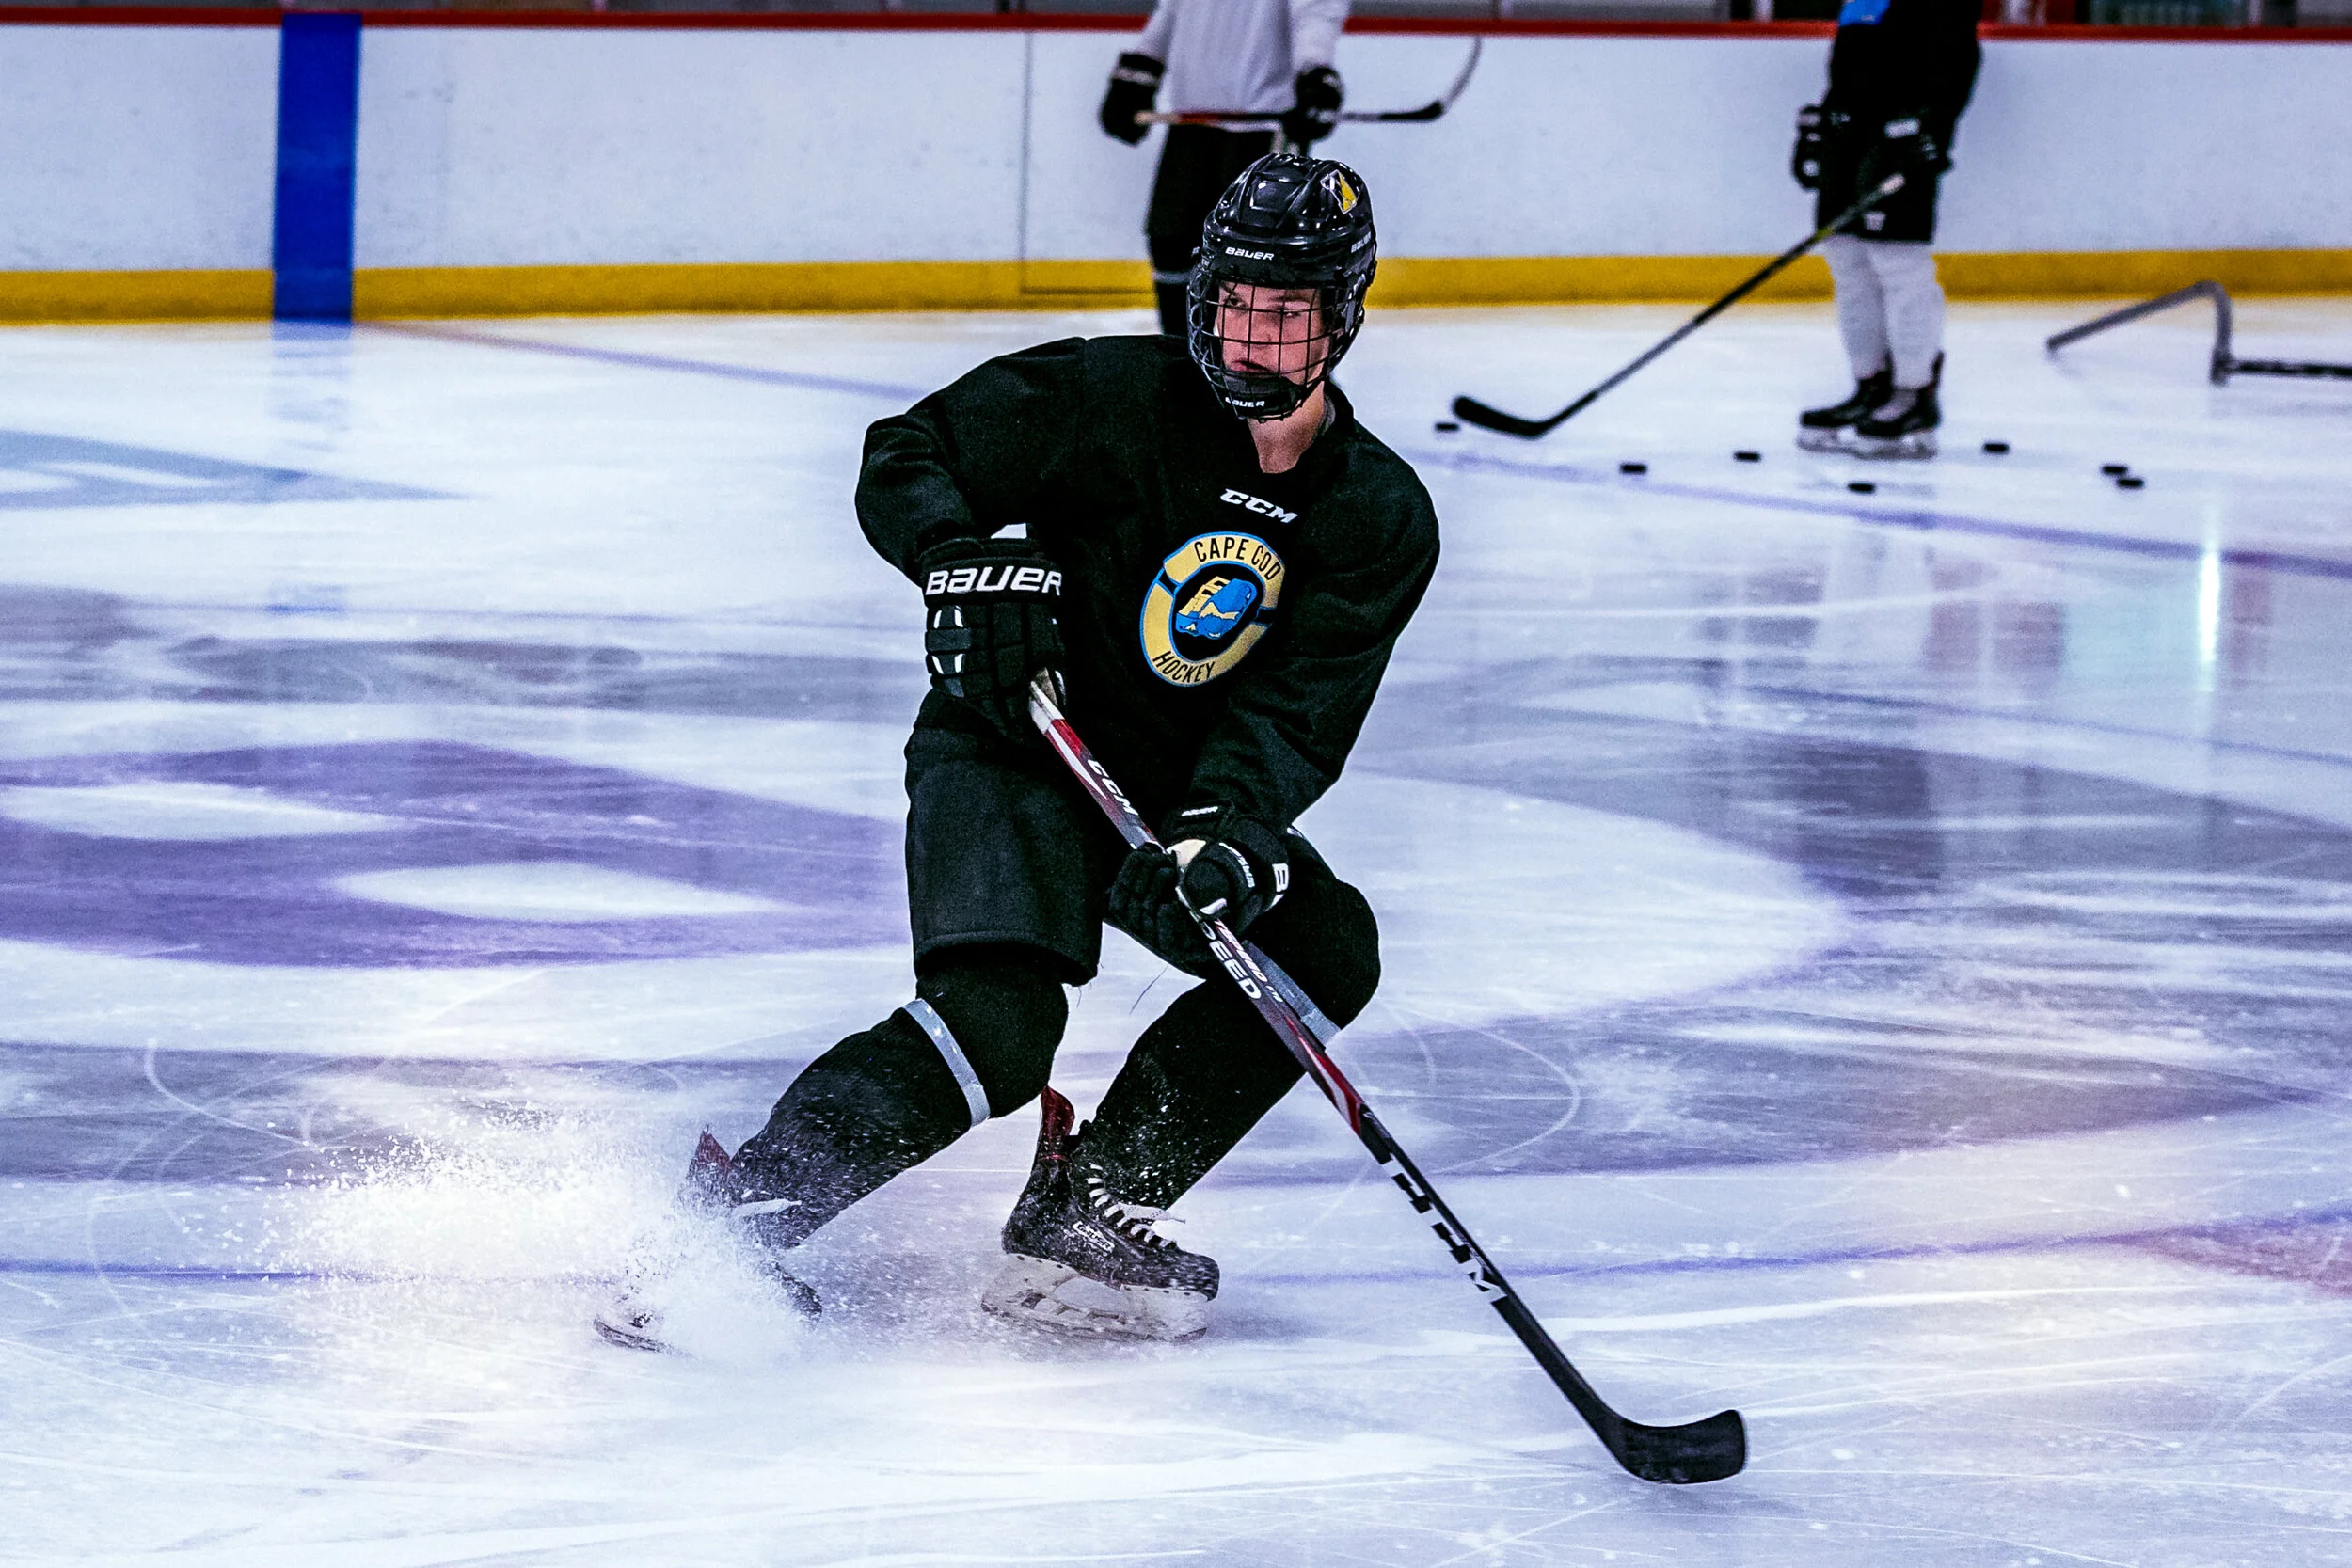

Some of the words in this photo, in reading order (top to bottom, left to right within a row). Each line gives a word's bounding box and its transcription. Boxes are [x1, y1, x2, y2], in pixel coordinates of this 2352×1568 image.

[1219, 488, 1298, 524] CCM
[1193, 536, 1249, 562] CAPE
[1250, 544, 1283, 581] COD
[1152, 650, 1216, 684] HOCKEY
[1087, 759, 1139, 816] CCM
